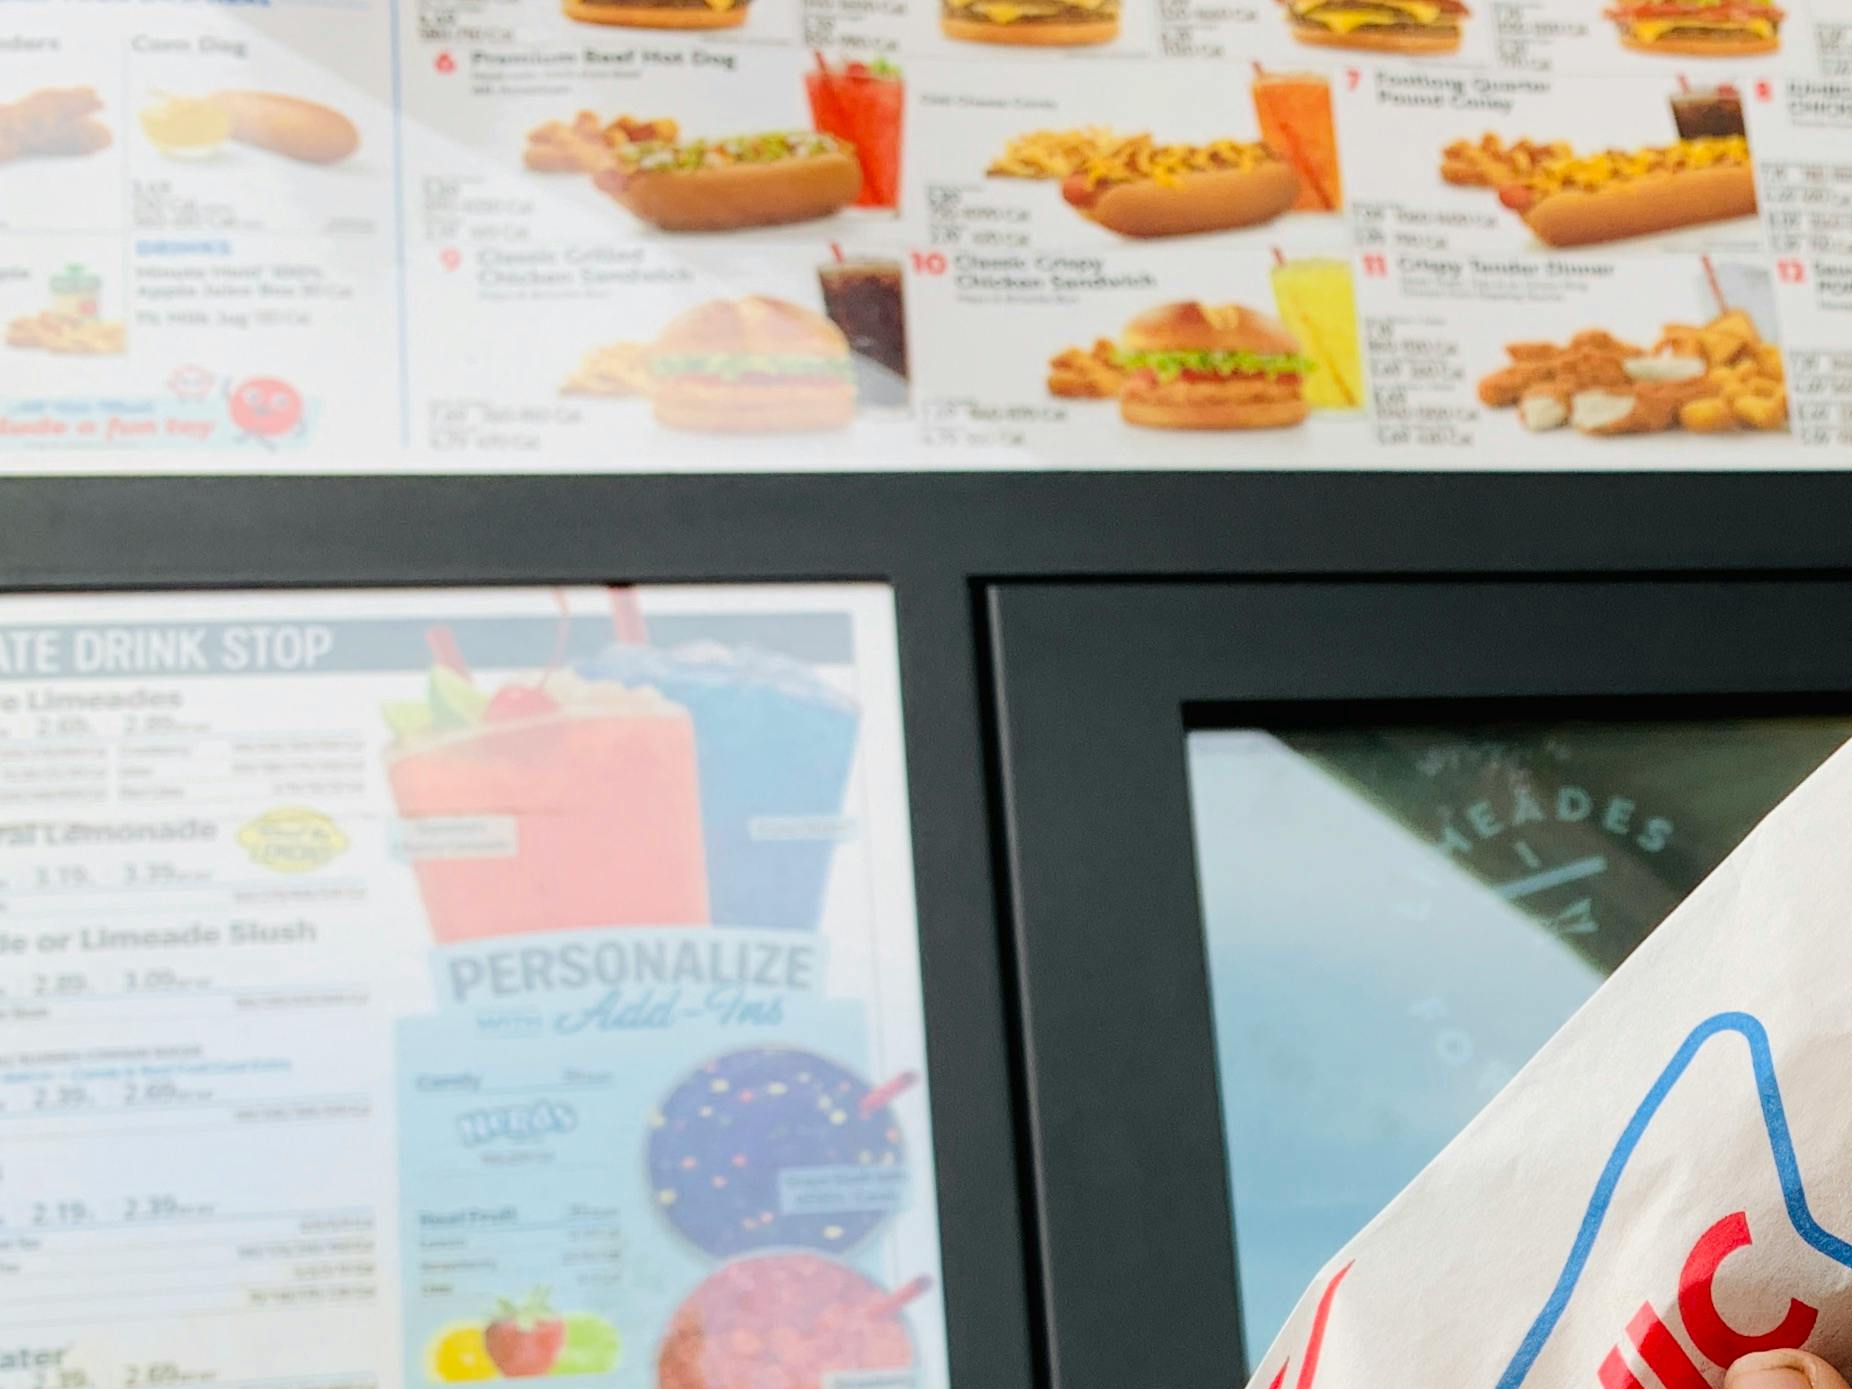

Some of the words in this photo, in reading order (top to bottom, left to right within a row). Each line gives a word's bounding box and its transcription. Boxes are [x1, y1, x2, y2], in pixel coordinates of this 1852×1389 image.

[470, 49, 578, 67] Premium
[583, 48, 634, 65] Beef
[641, 50, 684, 66] Hot
[691, 51, 737, 71] Dog
[1344, 68, 1361, 91] 7
[909, 249, 948, 277] 10
[75, 627, 207, 672] DRINK
[222, 624, 333, 670] STOP
[28, 688, 185, 711] Limeades
[45, 819, 218, 846] Lemonade
[80, 923, 220, 952] Limeade
[229, 916, 317, 946] Slush
[448, 939, 815, 1003] PERSONALIZE
